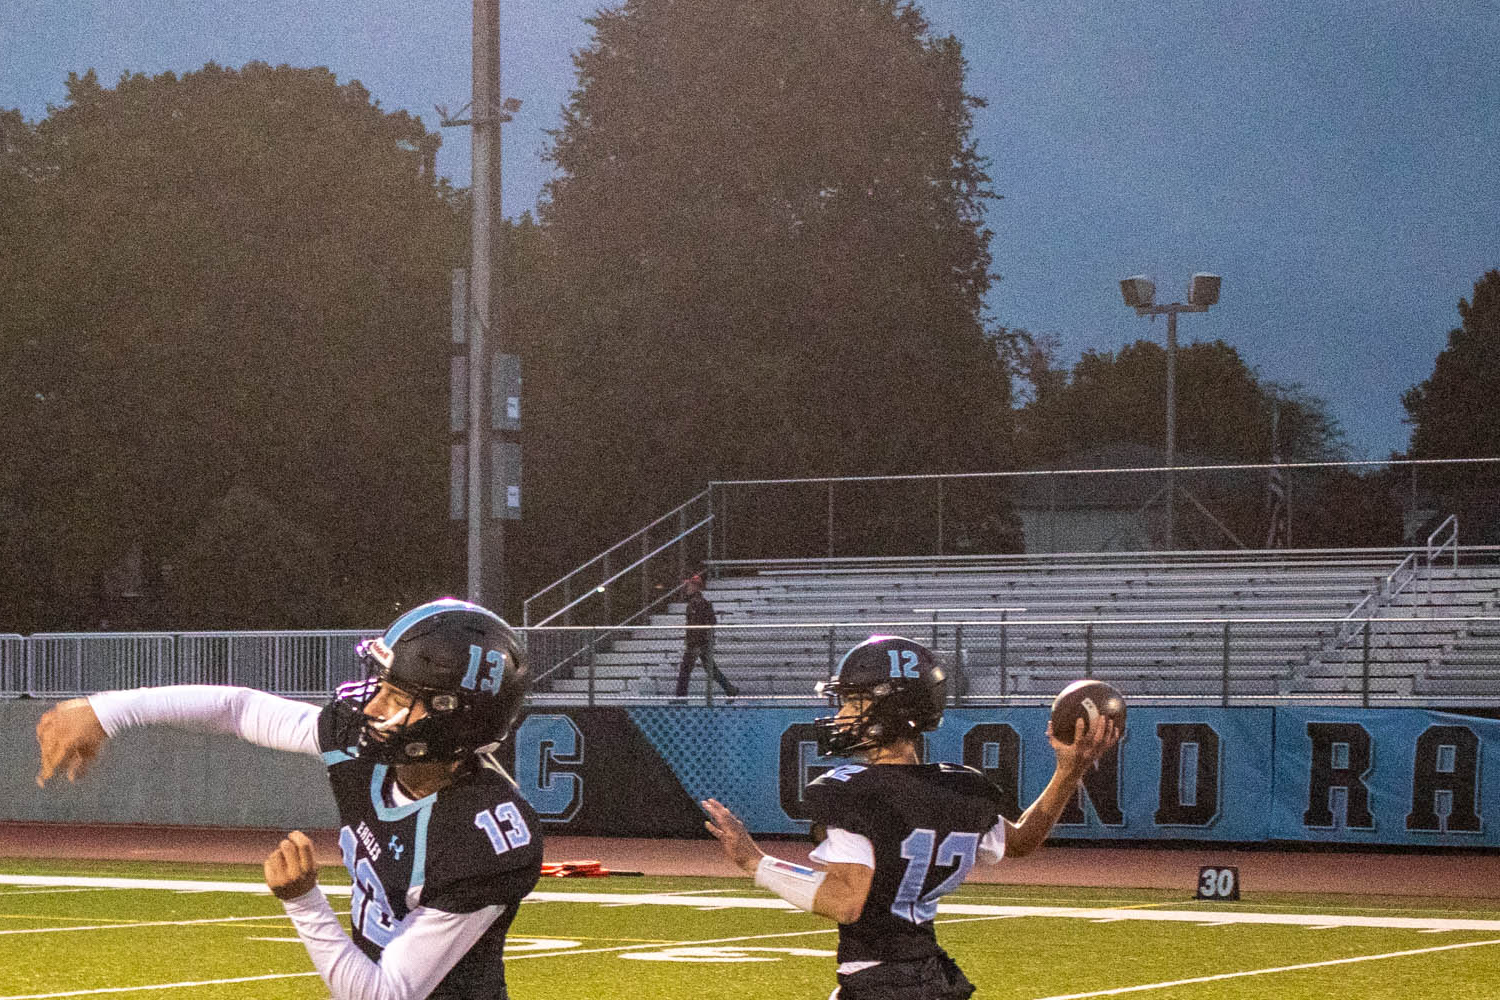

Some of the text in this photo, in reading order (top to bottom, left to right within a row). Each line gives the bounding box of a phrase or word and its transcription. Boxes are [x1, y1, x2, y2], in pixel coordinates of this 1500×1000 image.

[460, 644, 506, 697] 13
[888, 650, 919, 678] 12
[1302, 721, 1484, 834] RA
[356, 821, 382, 862] EAGLES
[474, 801, 532, 855] 13
[890, 828, 979, 925] 12
[1200, 869, 1234, 897] 30
